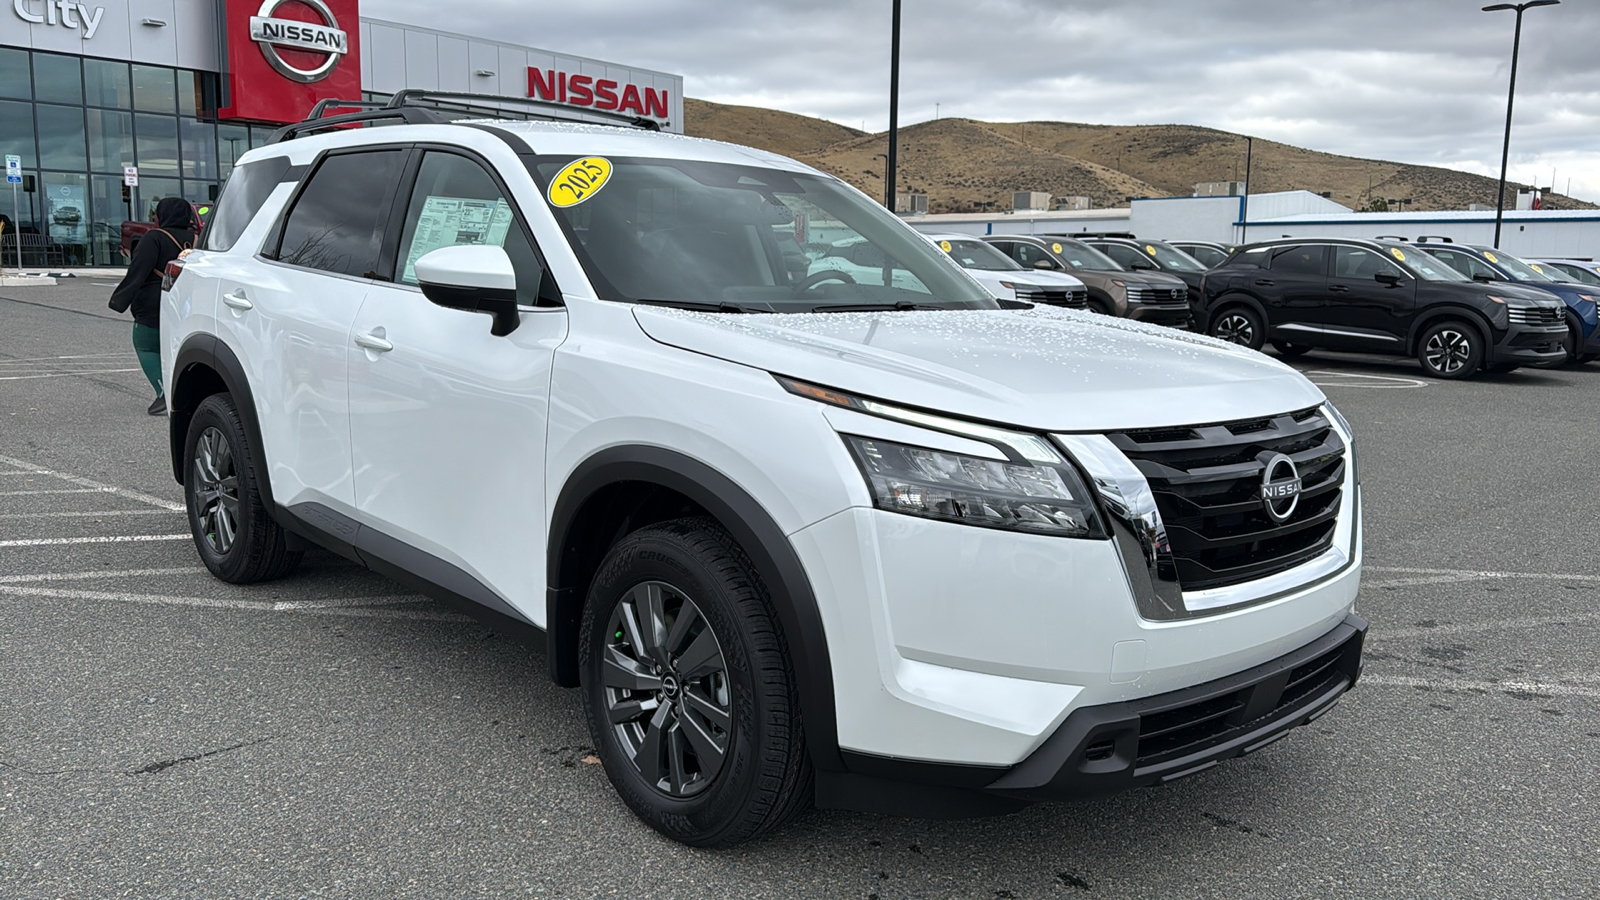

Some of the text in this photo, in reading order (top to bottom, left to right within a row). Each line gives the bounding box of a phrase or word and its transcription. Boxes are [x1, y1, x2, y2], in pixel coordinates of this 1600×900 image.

[14, 0, 105, 39] City
[263, 23, 341, 48] NISSAN
[527, 66, 669, 118] NISSAN
[558, 160, 603, 199] 2025
[1263, 481, 1302, 498] NISSAN
